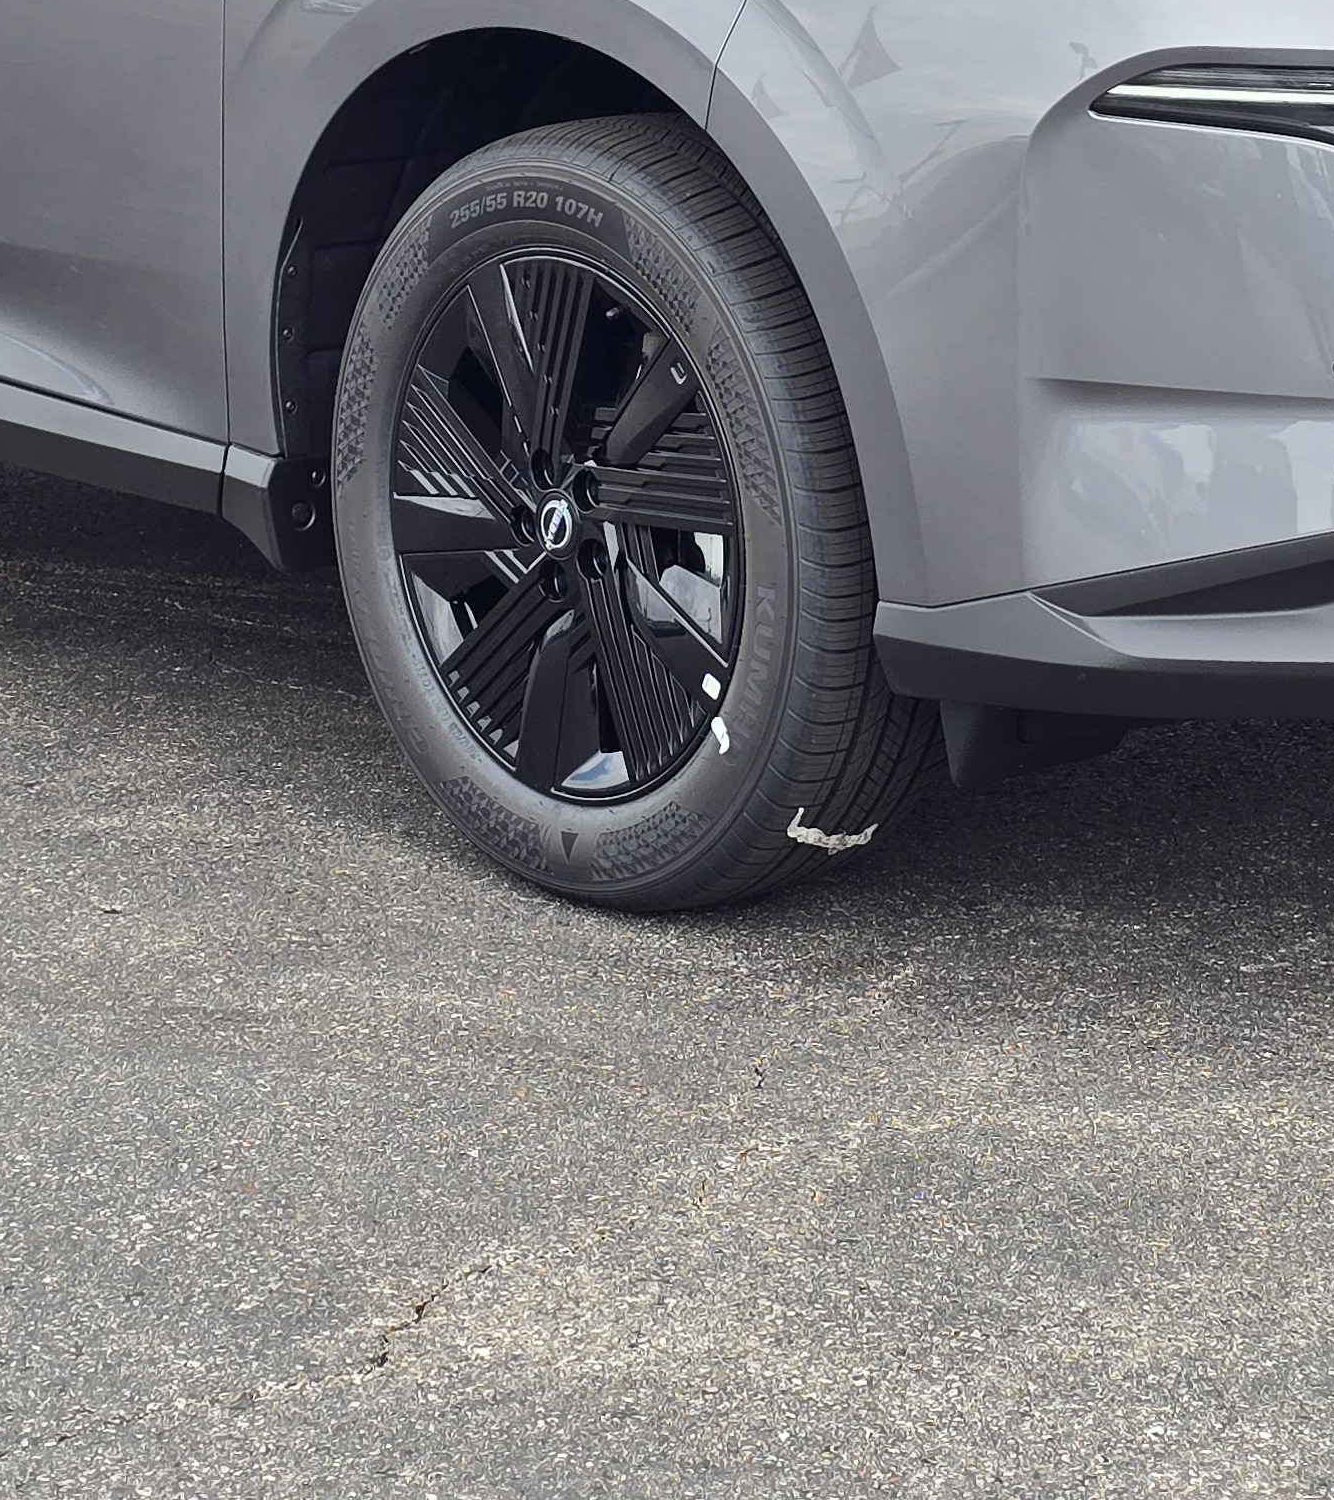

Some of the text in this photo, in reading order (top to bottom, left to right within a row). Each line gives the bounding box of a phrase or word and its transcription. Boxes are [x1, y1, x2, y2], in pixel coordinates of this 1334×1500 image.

[449, 190, 604, 229] 255/55 R20 107H
